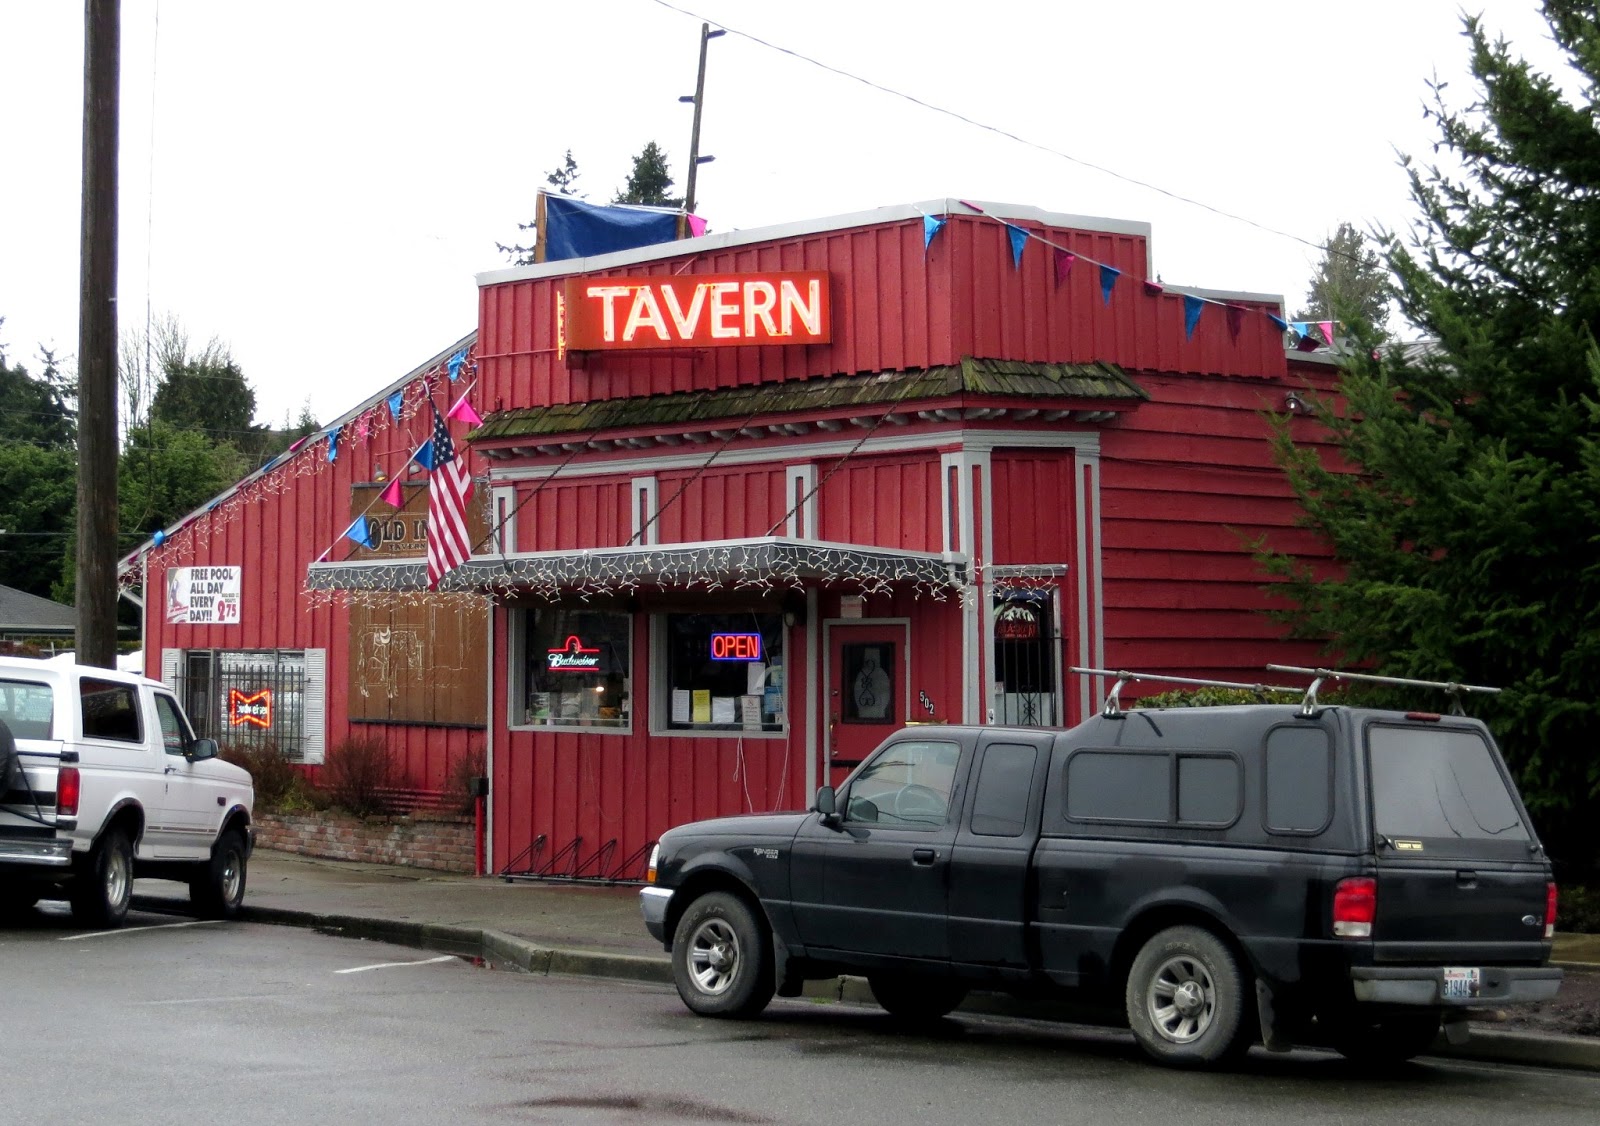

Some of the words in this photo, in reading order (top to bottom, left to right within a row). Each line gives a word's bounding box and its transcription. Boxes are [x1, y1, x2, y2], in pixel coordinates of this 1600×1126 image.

[587, 279, 821, 342] TAVERN
[367, 516, 406, 552] OLD
[412, 519, 428, 541] IN
[389, 543, 426, 551] TAVERN
[191, 568, 208, 580] FREE
[211, 568, 233, 580] POOL
[190, 582, 205, 594] ALL
[207, 582, 224, 594] DAY
[190, 596, 215, 608] EVERY
[189, 610, 212, 622] DAY!!
[713, 635, 759, 658] OPEN
[548, 653, 599, 667] Budweiser
[919, 691, 934, 715] 502
